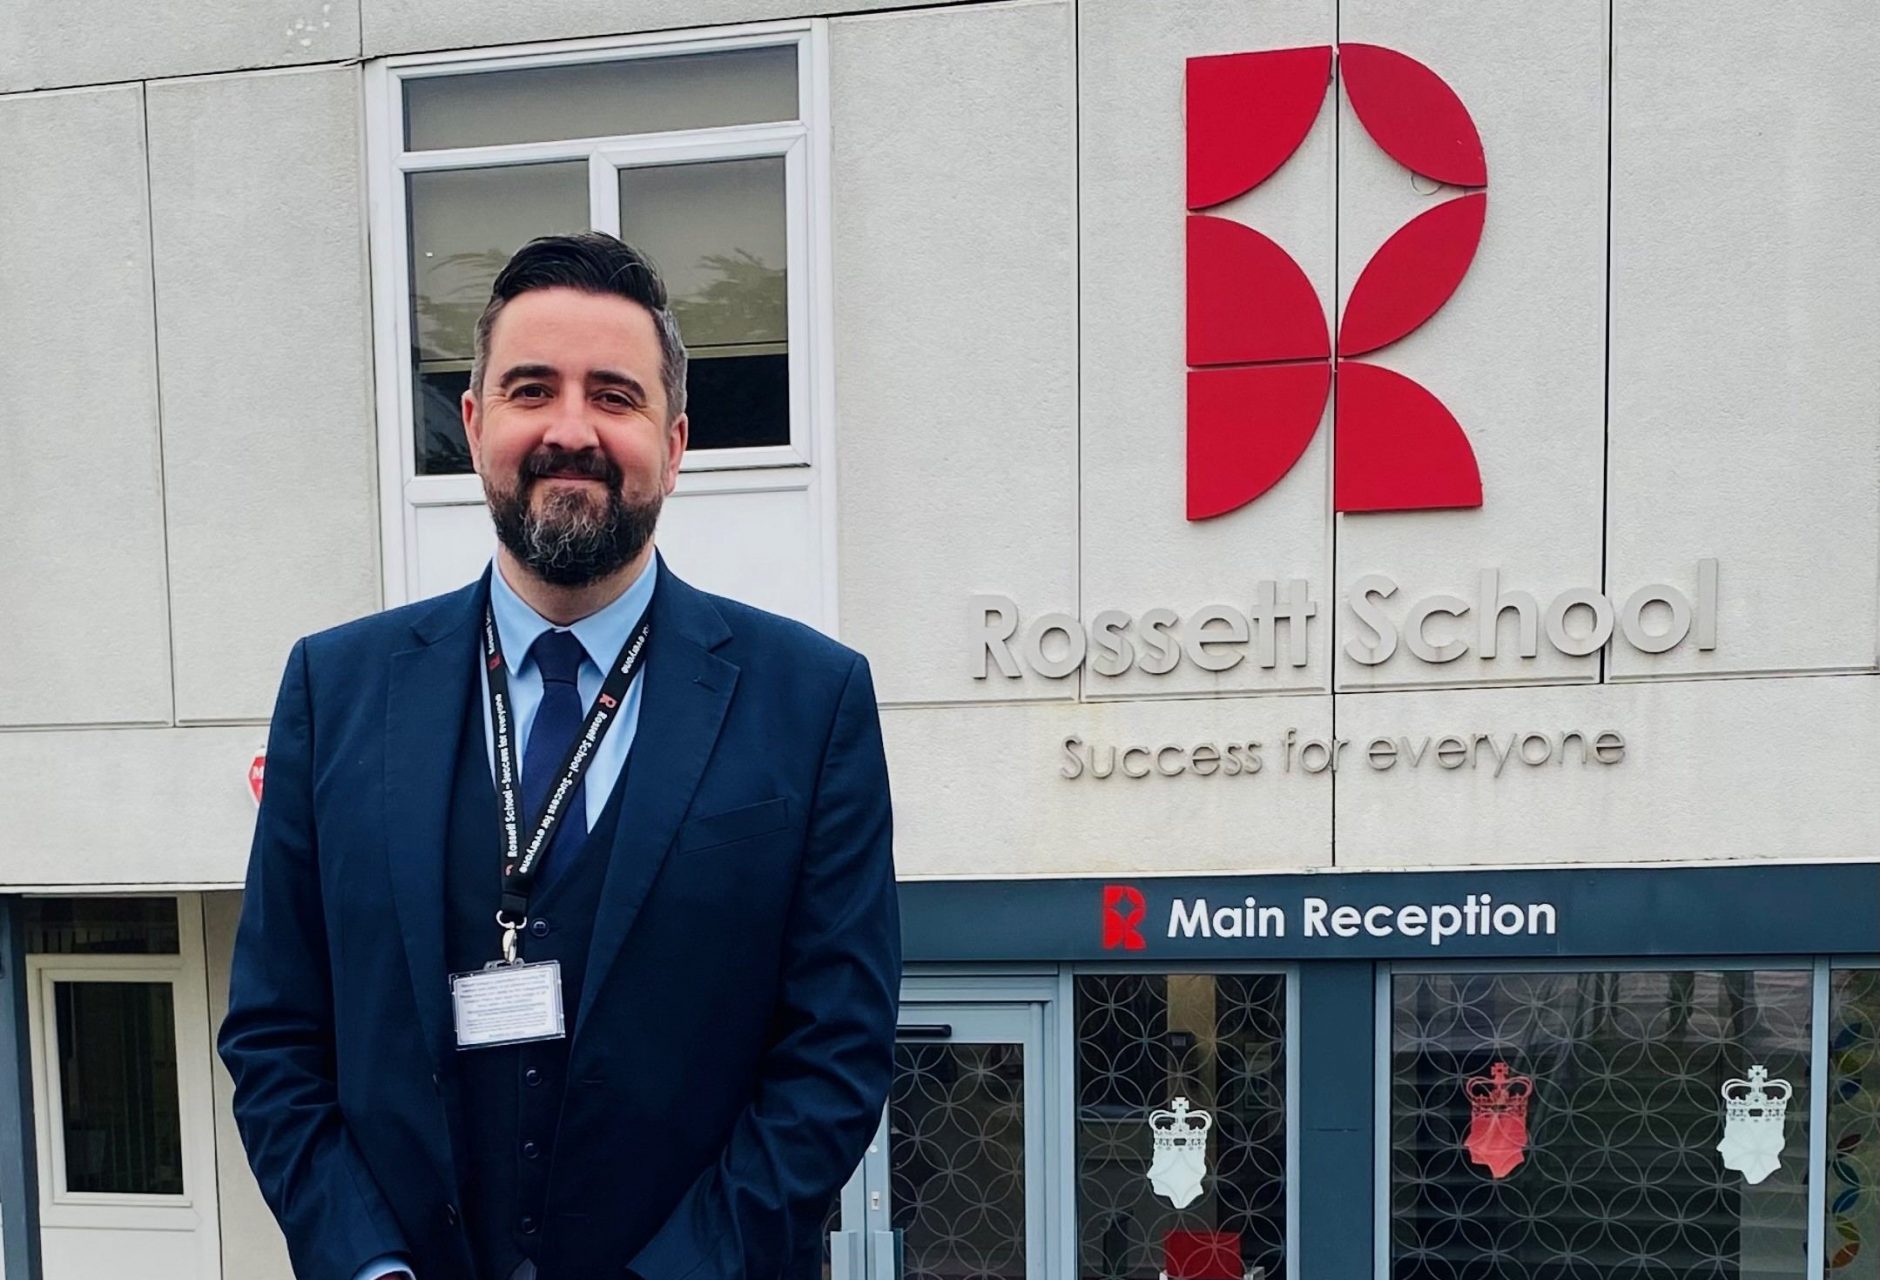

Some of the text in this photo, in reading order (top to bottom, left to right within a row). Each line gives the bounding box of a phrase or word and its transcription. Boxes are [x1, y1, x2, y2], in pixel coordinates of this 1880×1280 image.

[969, 557, 1719, 680] Rossett School
[495, 693, 506, 734] everyone
[585, 710, 608, 742] Rossett
[498, 734, 508, 748] for
[568, 739, 593, 773] School
[1060, 727, 1626, 780] Success for everyone
[501, 747, 512, 784] Success
[502, 789, 515, 822] School
[547, 777, 573, 815] Success
[505, 823, 518, 857] Rossett
[541, 815, 555, 829] for
[519, 828, 546, 873] everyone
[1167, 896, 1286, 939] Main
[1303, 893, 1557, 946] Reception
